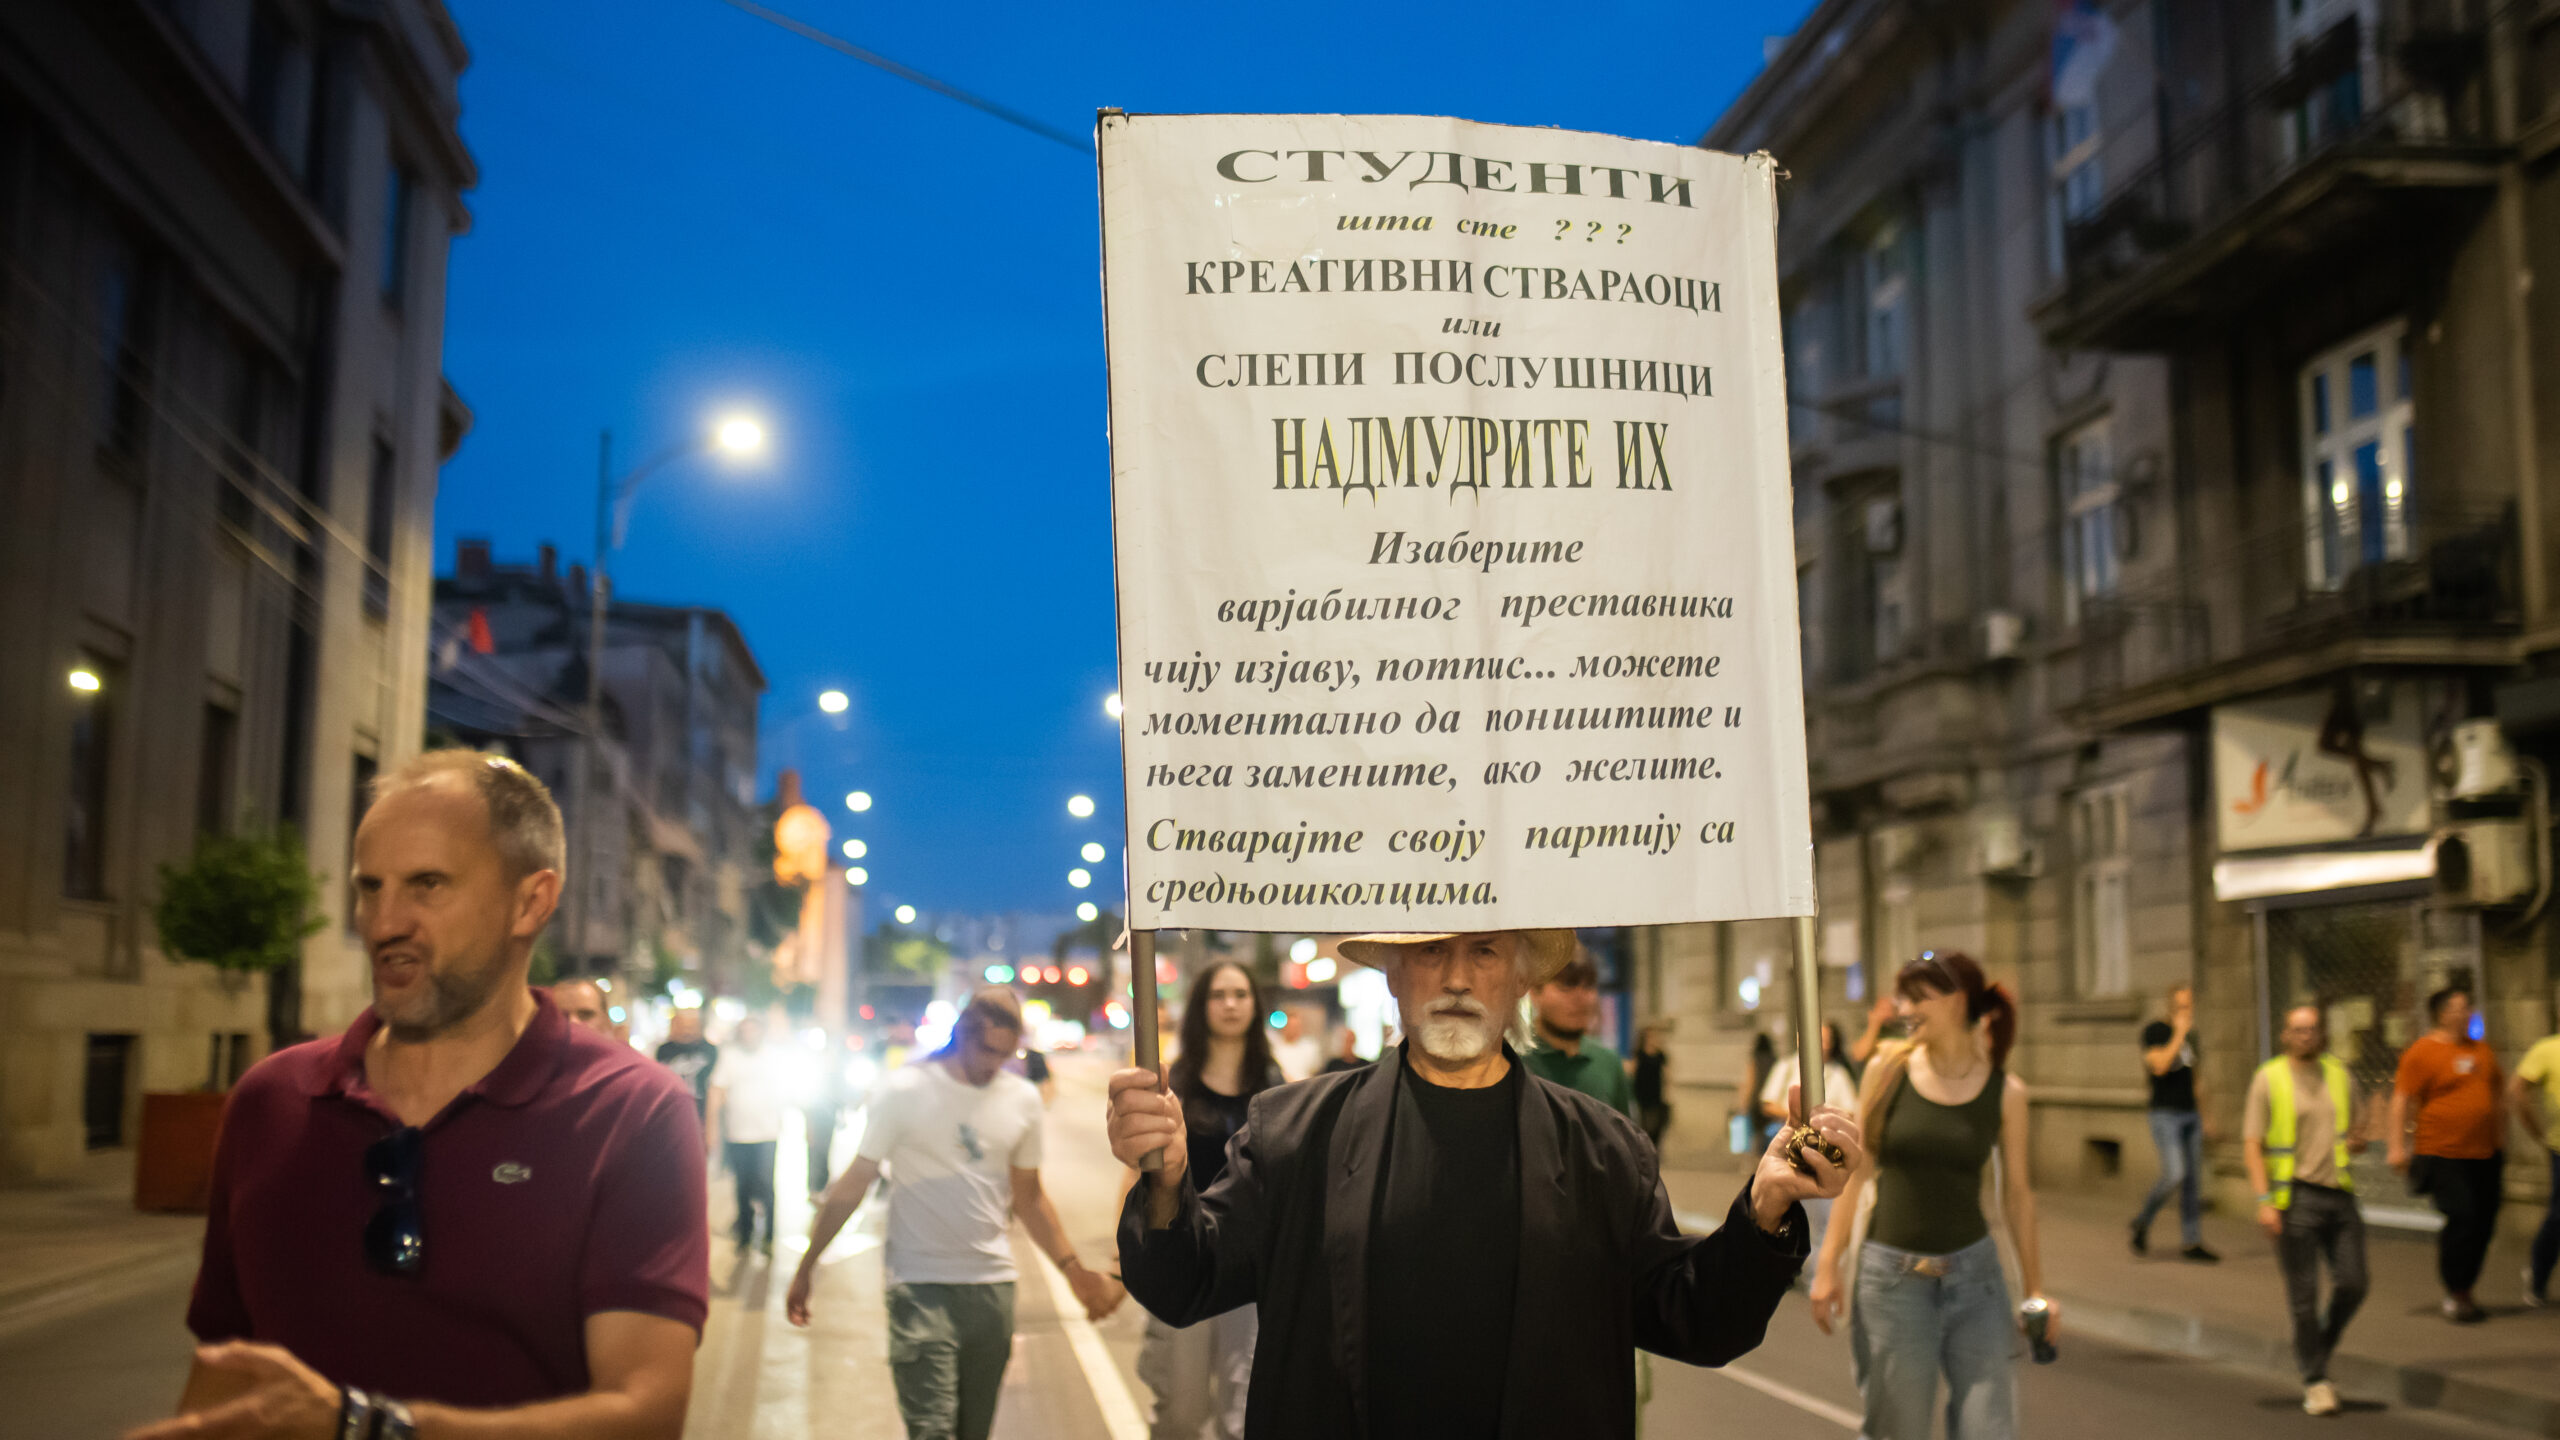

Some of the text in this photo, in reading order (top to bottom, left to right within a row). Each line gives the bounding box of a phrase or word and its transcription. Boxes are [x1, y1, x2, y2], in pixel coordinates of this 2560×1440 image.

[1216, 149, 1696, 208] СТУДЕНТИ
[1336, 215, 1433, 232] шта
[1456, 219, 1517, 240] сте
[1186, 259, 1721, 316] КРЕАТИВНИ СТВАРАОЦИ
[1441, 316, 1501, 338] или
[1196, 351, 1713, 401] СЛЕПИ ПОСЛУШНИЦИ
[1271, 415, 1673, 507] НАДМУДРИТЕ ИХ
[1368, 530, 1584, 574] Изаберите
[1217, 588, 1733, 632] варјабилног преставника
[1144, 650, 1721, 694] чију изјаву, потпис... можете
[1142, 701, 1742, 736] моментално да поништите и
[1146, 757, 1722, 793] њега замените, ако желите.
[1146, 812, 1735, 864] Стварајте своју партију са
[1146, 872, 1498, 913] средњошколцима.
